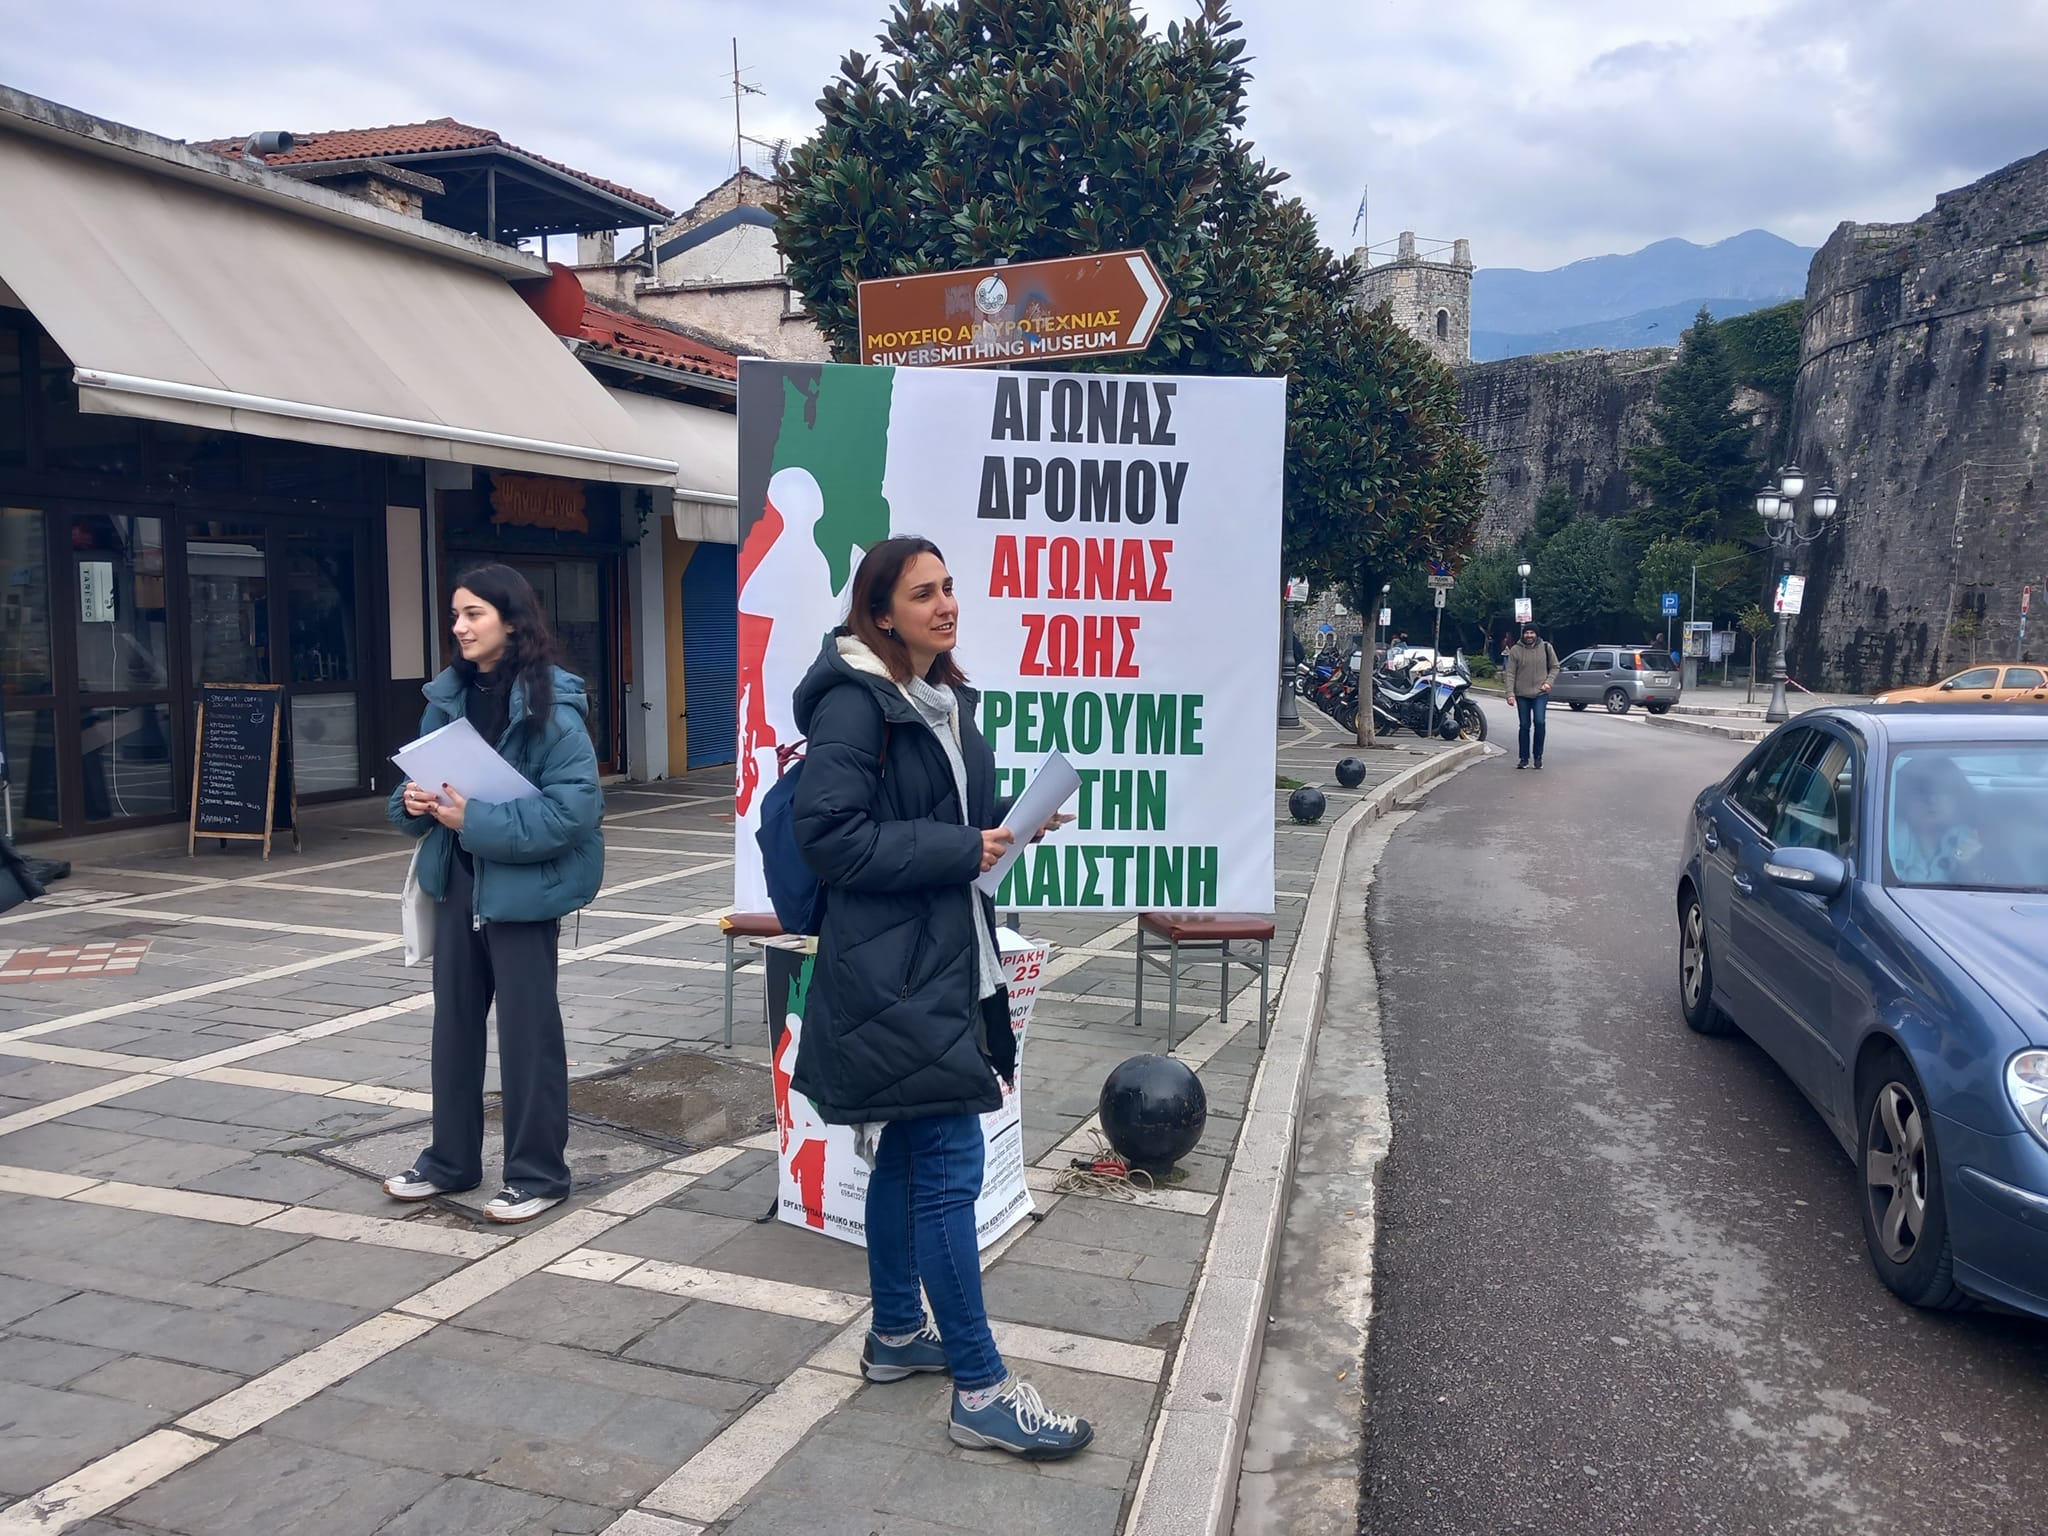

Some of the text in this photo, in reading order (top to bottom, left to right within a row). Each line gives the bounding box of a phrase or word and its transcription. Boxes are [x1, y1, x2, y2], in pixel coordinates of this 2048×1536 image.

[868, 326, 952, 349] ΜΟΥΣΕΙΟ
[872, 330, 1116, 366] SILVERSMITHING MUSEUM
[991, 376, 1177, 446] ΑΓΩΝΑΣ
[977, 456, 1189, 524] ΔΡΟΜΟΥ
[988, 535, 1173, 602] ΑΓΩΝΑΣ
[1019, 614, 1141, 678] ΖΩΗΣ
[976, 691, 1204, 755] ΡΕΧΟΥΜΕ
[1076, 769, 1167, 831] ΤΗΝ
[995, 845, 1218, 907] ΛΑΙΣΤΙΝΗ
[1001, 950, 1045, 967] ΡΙΑΚΗ
[1012, 963, 1041, 983] 25
